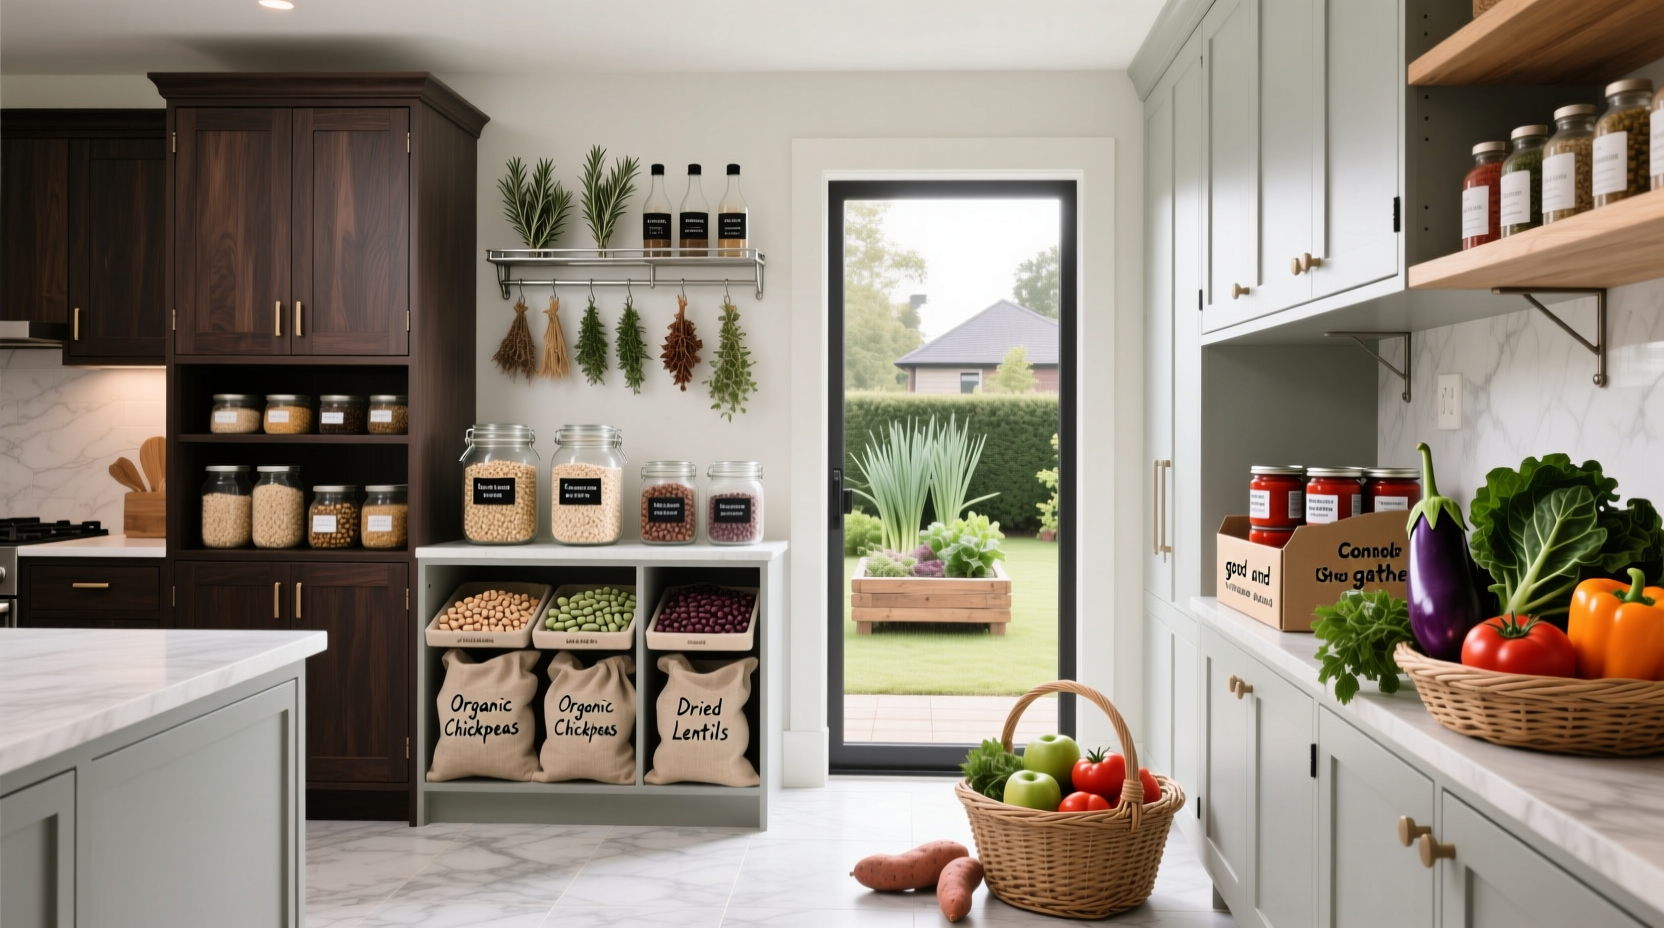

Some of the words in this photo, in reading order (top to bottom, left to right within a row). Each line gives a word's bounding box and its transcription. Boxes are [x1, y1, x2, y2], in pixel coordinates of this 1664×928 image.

[1226, 559, 1247, 580] good
[1252, 566, 1270, 586] and
[451, 694, 512, 720] Organic
[677, 697, 722, 716] Dried
[445, 718, 519, 744] Chickpeas
[672, 720, 728, 741] Lentils
